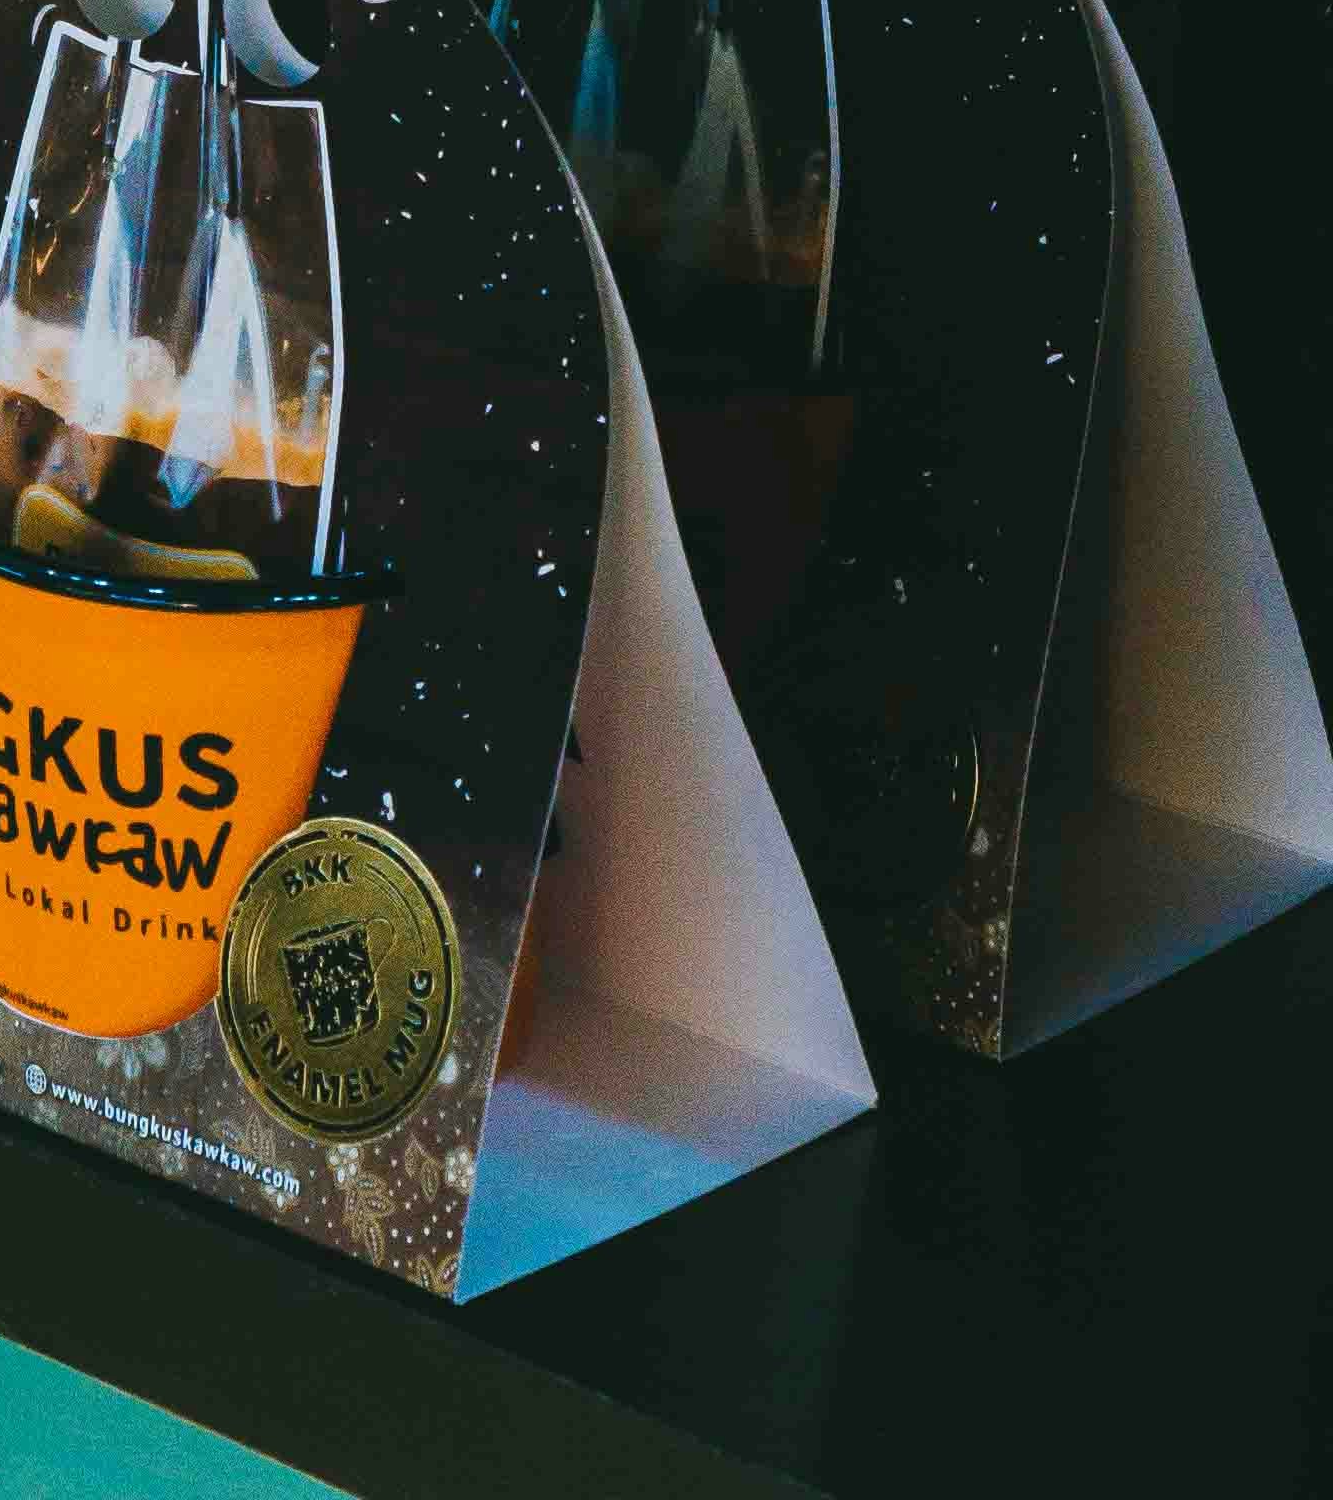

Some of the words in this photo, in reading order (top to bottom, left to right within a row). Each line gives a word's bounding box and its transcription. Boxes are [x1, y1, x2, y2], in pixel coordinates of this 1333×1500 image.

[4, 874, 90, 926] Lokal
[283, 851, 353, 899] BKK
[248, 1008, 384, 1111] ENAMEL
[382, 968, 435, 1077] MUG
[50, 1080, 302, 1198] www.bungkuskawkaw.com
